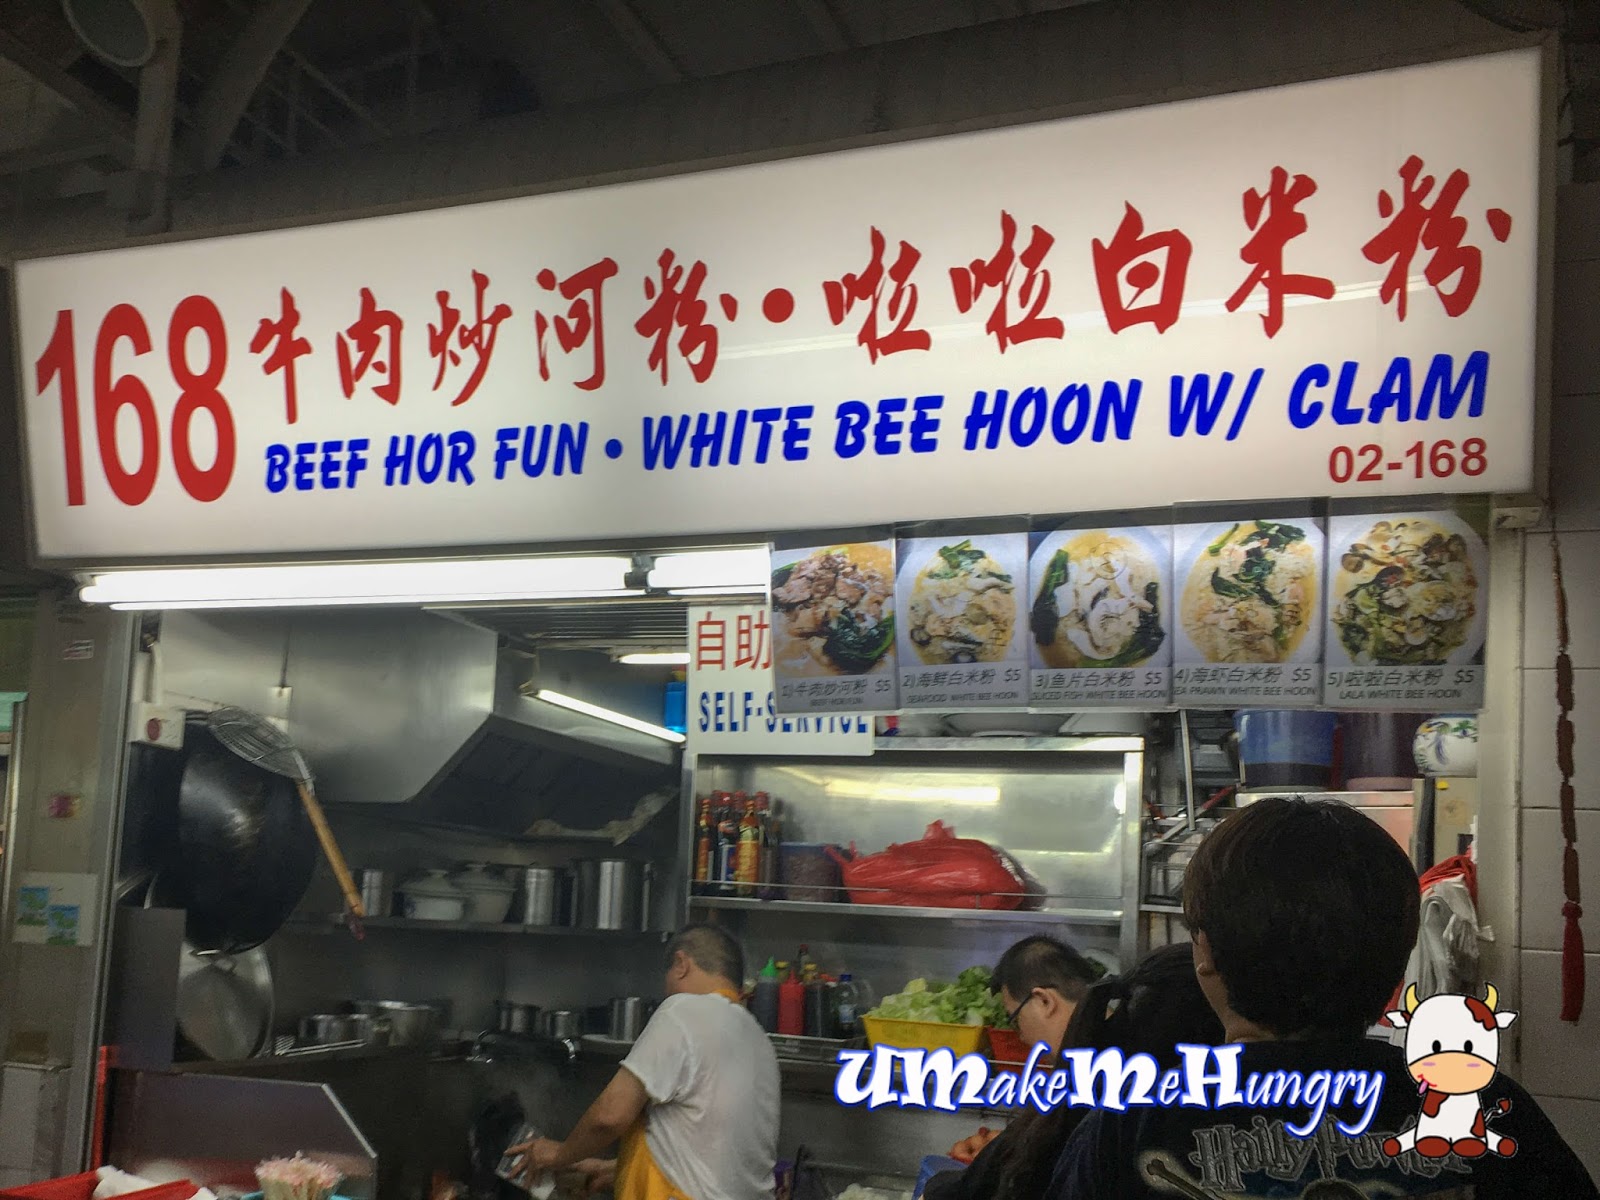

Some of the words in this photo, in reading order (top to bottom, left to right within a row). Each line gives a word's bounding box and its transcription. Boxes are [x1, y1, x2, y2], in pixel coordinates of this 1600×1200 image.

[36, 294, 237, 507] 168
[249, 249, 738, 425] 牛肉炒河粉
[822, 155, 1512, 363] 啦啦白米粉
[265, 437, 370, 494] BEEF
[383, 429, 477, 487] HOR
[493, 421, 590, 481] FUN
[642, 404, 815, 471] WHITE
[833, 394, 945, 460] BEE
[963, 378, 1143, 452] HOON
[1168, 367, 1265, 442] W/
[1287, 351, 1489, 430] CLAM
[1328, 438, 1486, 483] 02-168
[696, 610, 773, 671] 自助
[1004, 668, 1022, 683] $5
[1144, 670, 1163, 686] $5
[1292, 667, 1312, 682] $5
[1454, 669, 1475, 684] $5
